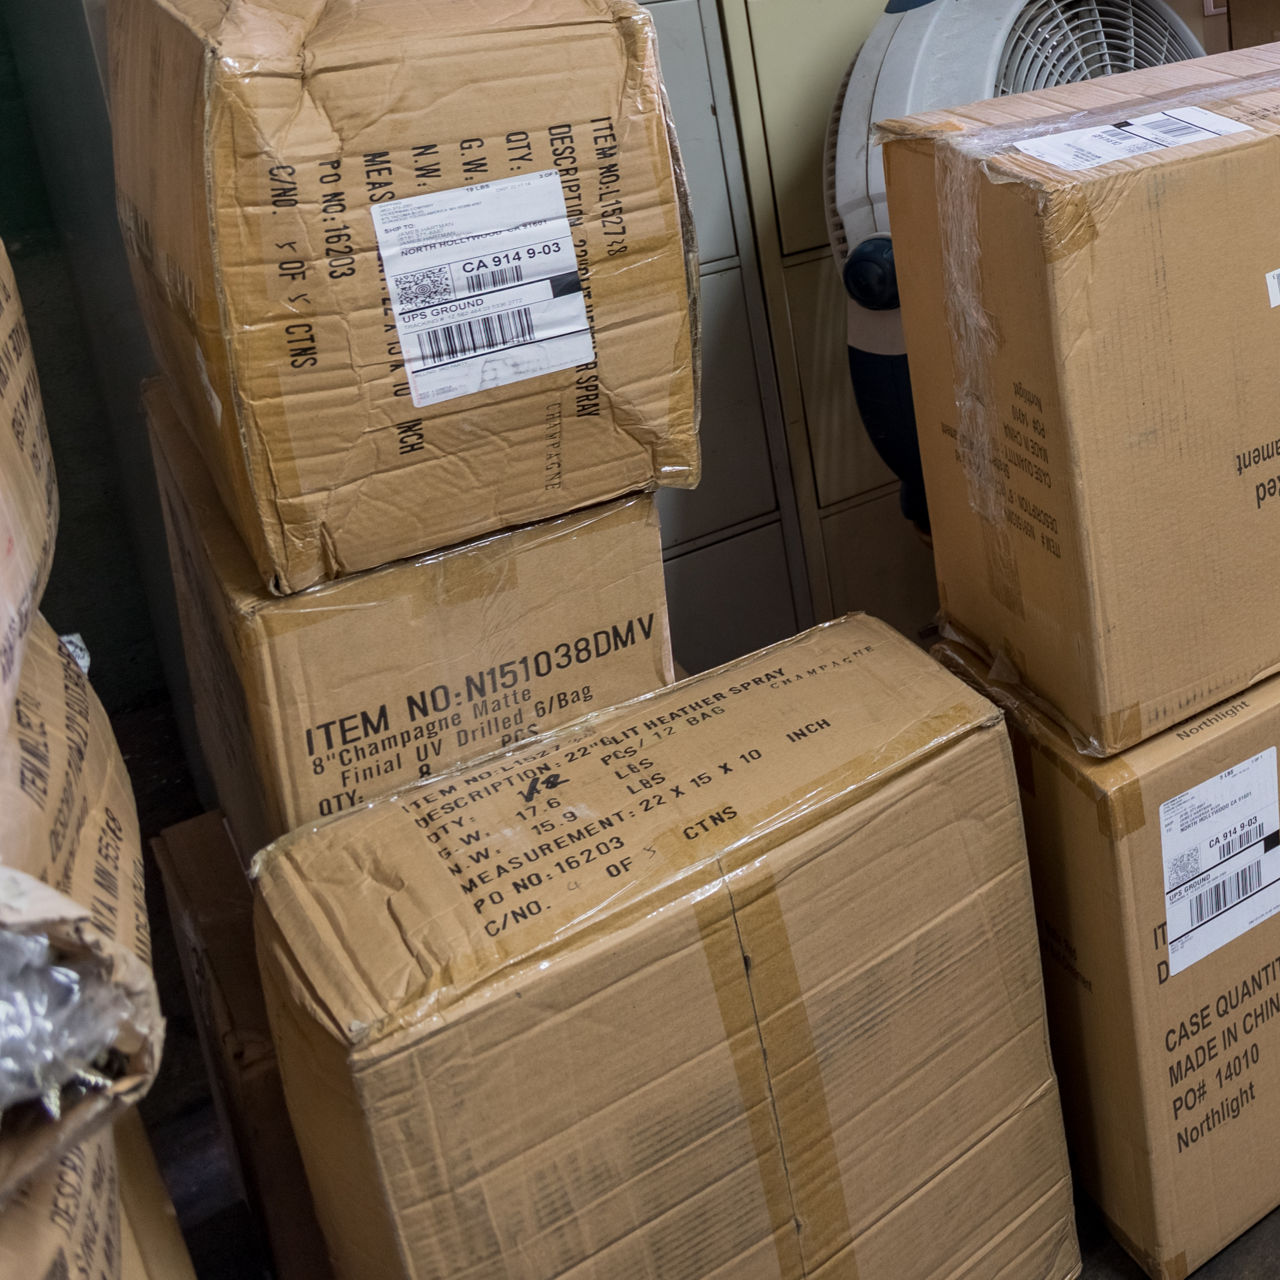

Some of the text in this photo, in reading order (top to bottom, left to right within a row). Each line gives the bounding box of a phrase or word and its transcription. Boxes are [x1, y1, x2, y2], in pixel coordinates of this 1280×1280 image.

[505, 130, 533, 171] QTY:
[590, 116, 616, 160] ITEM
[319, 159, 341, 184] PO
[384, 226, 400, 234] SHIP
[401, 243, 435, 257] NORTH
[438, 230, 501, 247] HOLLYWOOD
[278, 260, 306, 281] OF
[462, 241, 561, 273] CA 914 9-03
[402, 297, 484, 324] UPS GROUND
[285, 324, 318, 369] CTNS
[575, 374, 601, 418] SPRAY
[1013, 381, 1043, 413] Northlight
[396, 419, 425, 456] INCH
[770, 645, 875, 690] CHAMPAGNE
[473, 687, 532, 719] Matte
[643, 692, 728, 730] HEATHER
[728, 667, 786, 697] SPRAY
[305, 704, 390, 757] ITEM
[341, 684, 594, 788] Finial UV Drilled 6/Bag
[653, 726, 677, 741] 12
[685, 706, 726, 727] BAG
[1175, 700, 1250, 741] Northlight
[319, 790, 364, 816] QTY:
[501, 723, 539, 748] PCS
[514, 757, 654, 822] 17.6 LBS
[401, 785, 457, 814] ITEM
[460, 719, 831, 895] MEASUREMENT: 22 X 15 X 10 INCH
[531, 773, 666, 836] 15.9 LBS
[605, 856, 634, 879] OF
[682, 806, 739, 841] CTNS
[1209, 815, 1258, 849] CA 914 9-03
[473, 890, 505, 915] PO
[1168, 874, 1211, 902] UPS GROUND
[1164, 1006, 1210, 1054] CASE
[1168, 1040, 1218, 1089] MADE
[1222, 1023, 1238, 1052] IN
[1172, 1043, 1260, 1120] PO# 14010
[1176, 1081, 1257, 1154] Northlight
